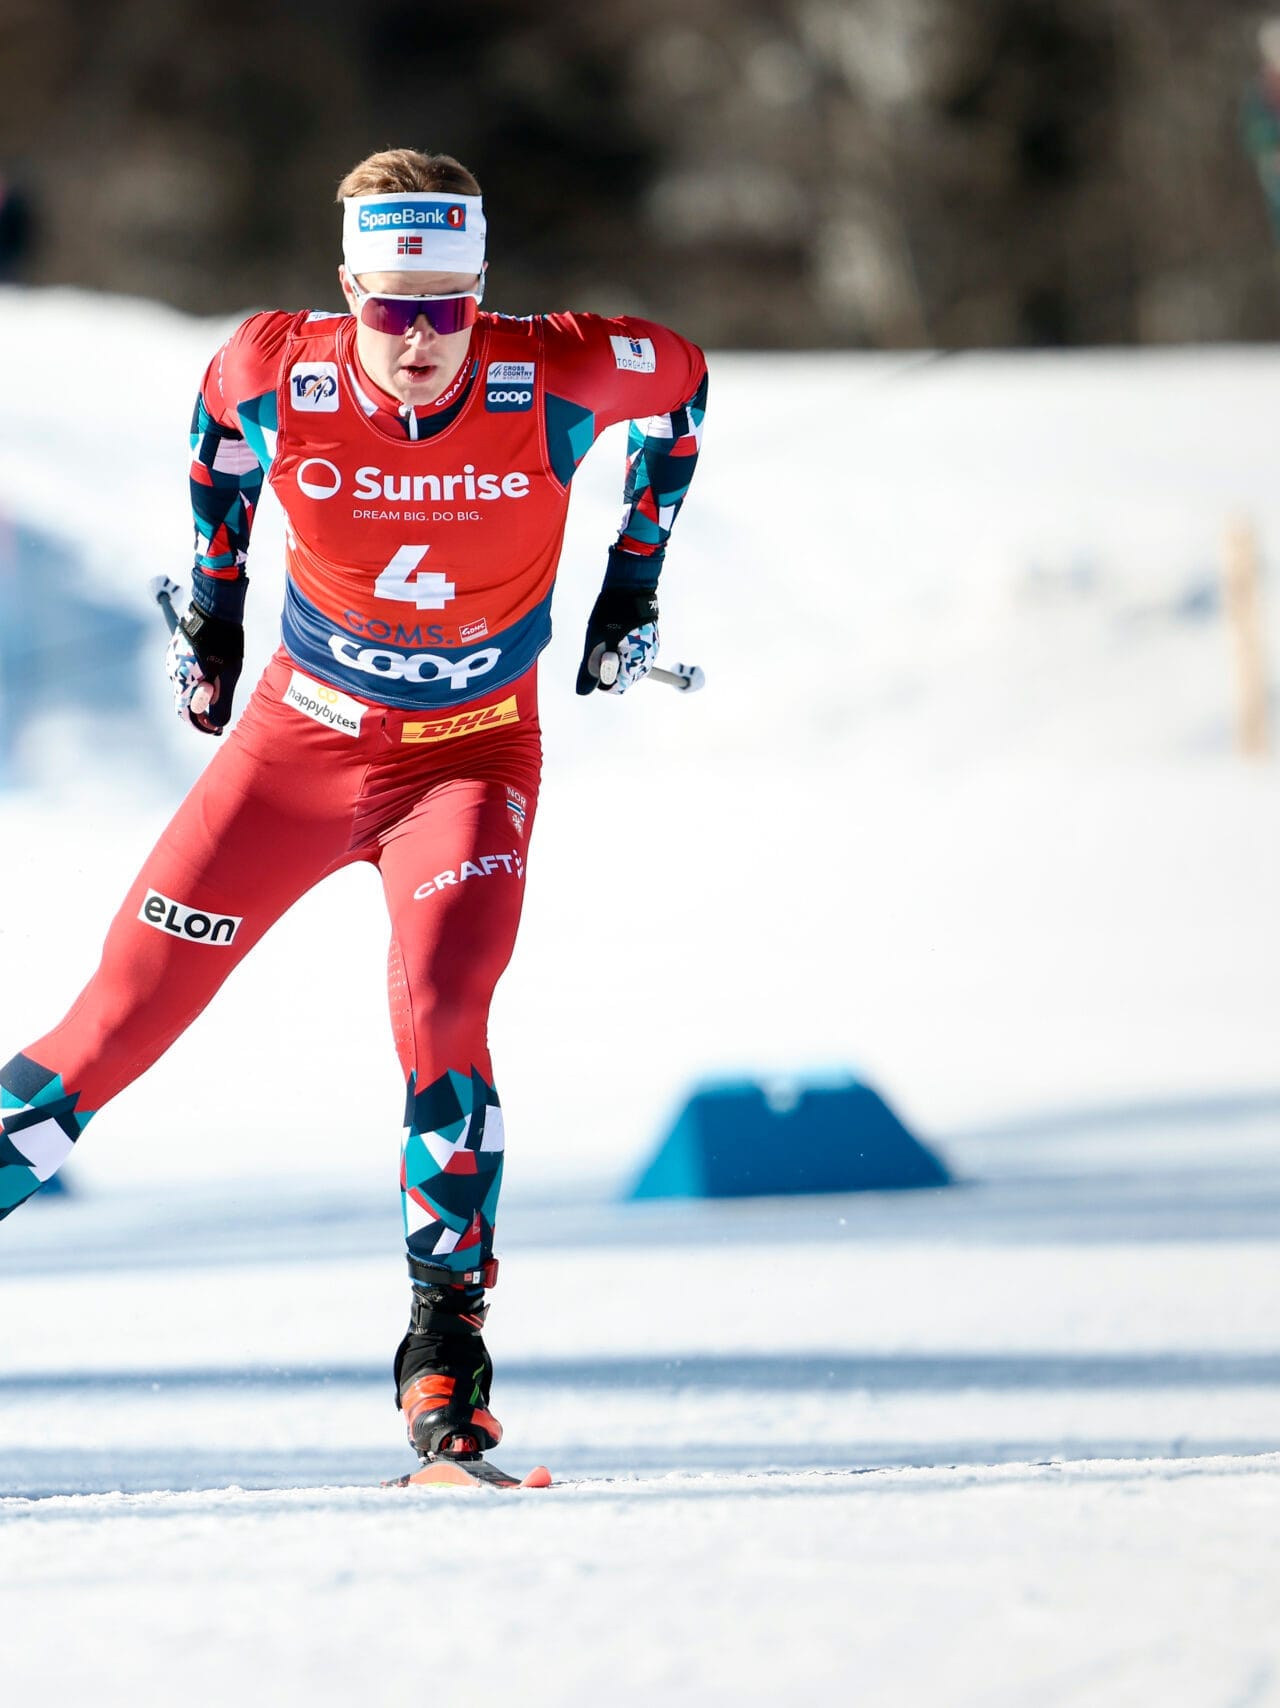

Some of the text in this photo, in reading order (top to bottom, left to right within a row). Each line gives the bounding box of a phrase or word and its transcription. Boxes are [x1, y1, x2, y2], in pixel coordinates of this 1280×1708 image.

[361, 208, 460, 229] SpareBank 1
[487, 391, 532, 405] coop
[352, 464, 530, 501] Sunrise
[352, 509, 484, 521] DREAM BIG. DO BIG.
[373, 544, 456, 610] 4
[327, 634, 502, 690] coop
[287, 684, 358, 730] happybytes
[417, 706, 503, 739] DHL
[506, 785, 527, 808] NOR
[413, 853, 513, 900] CRAFT
